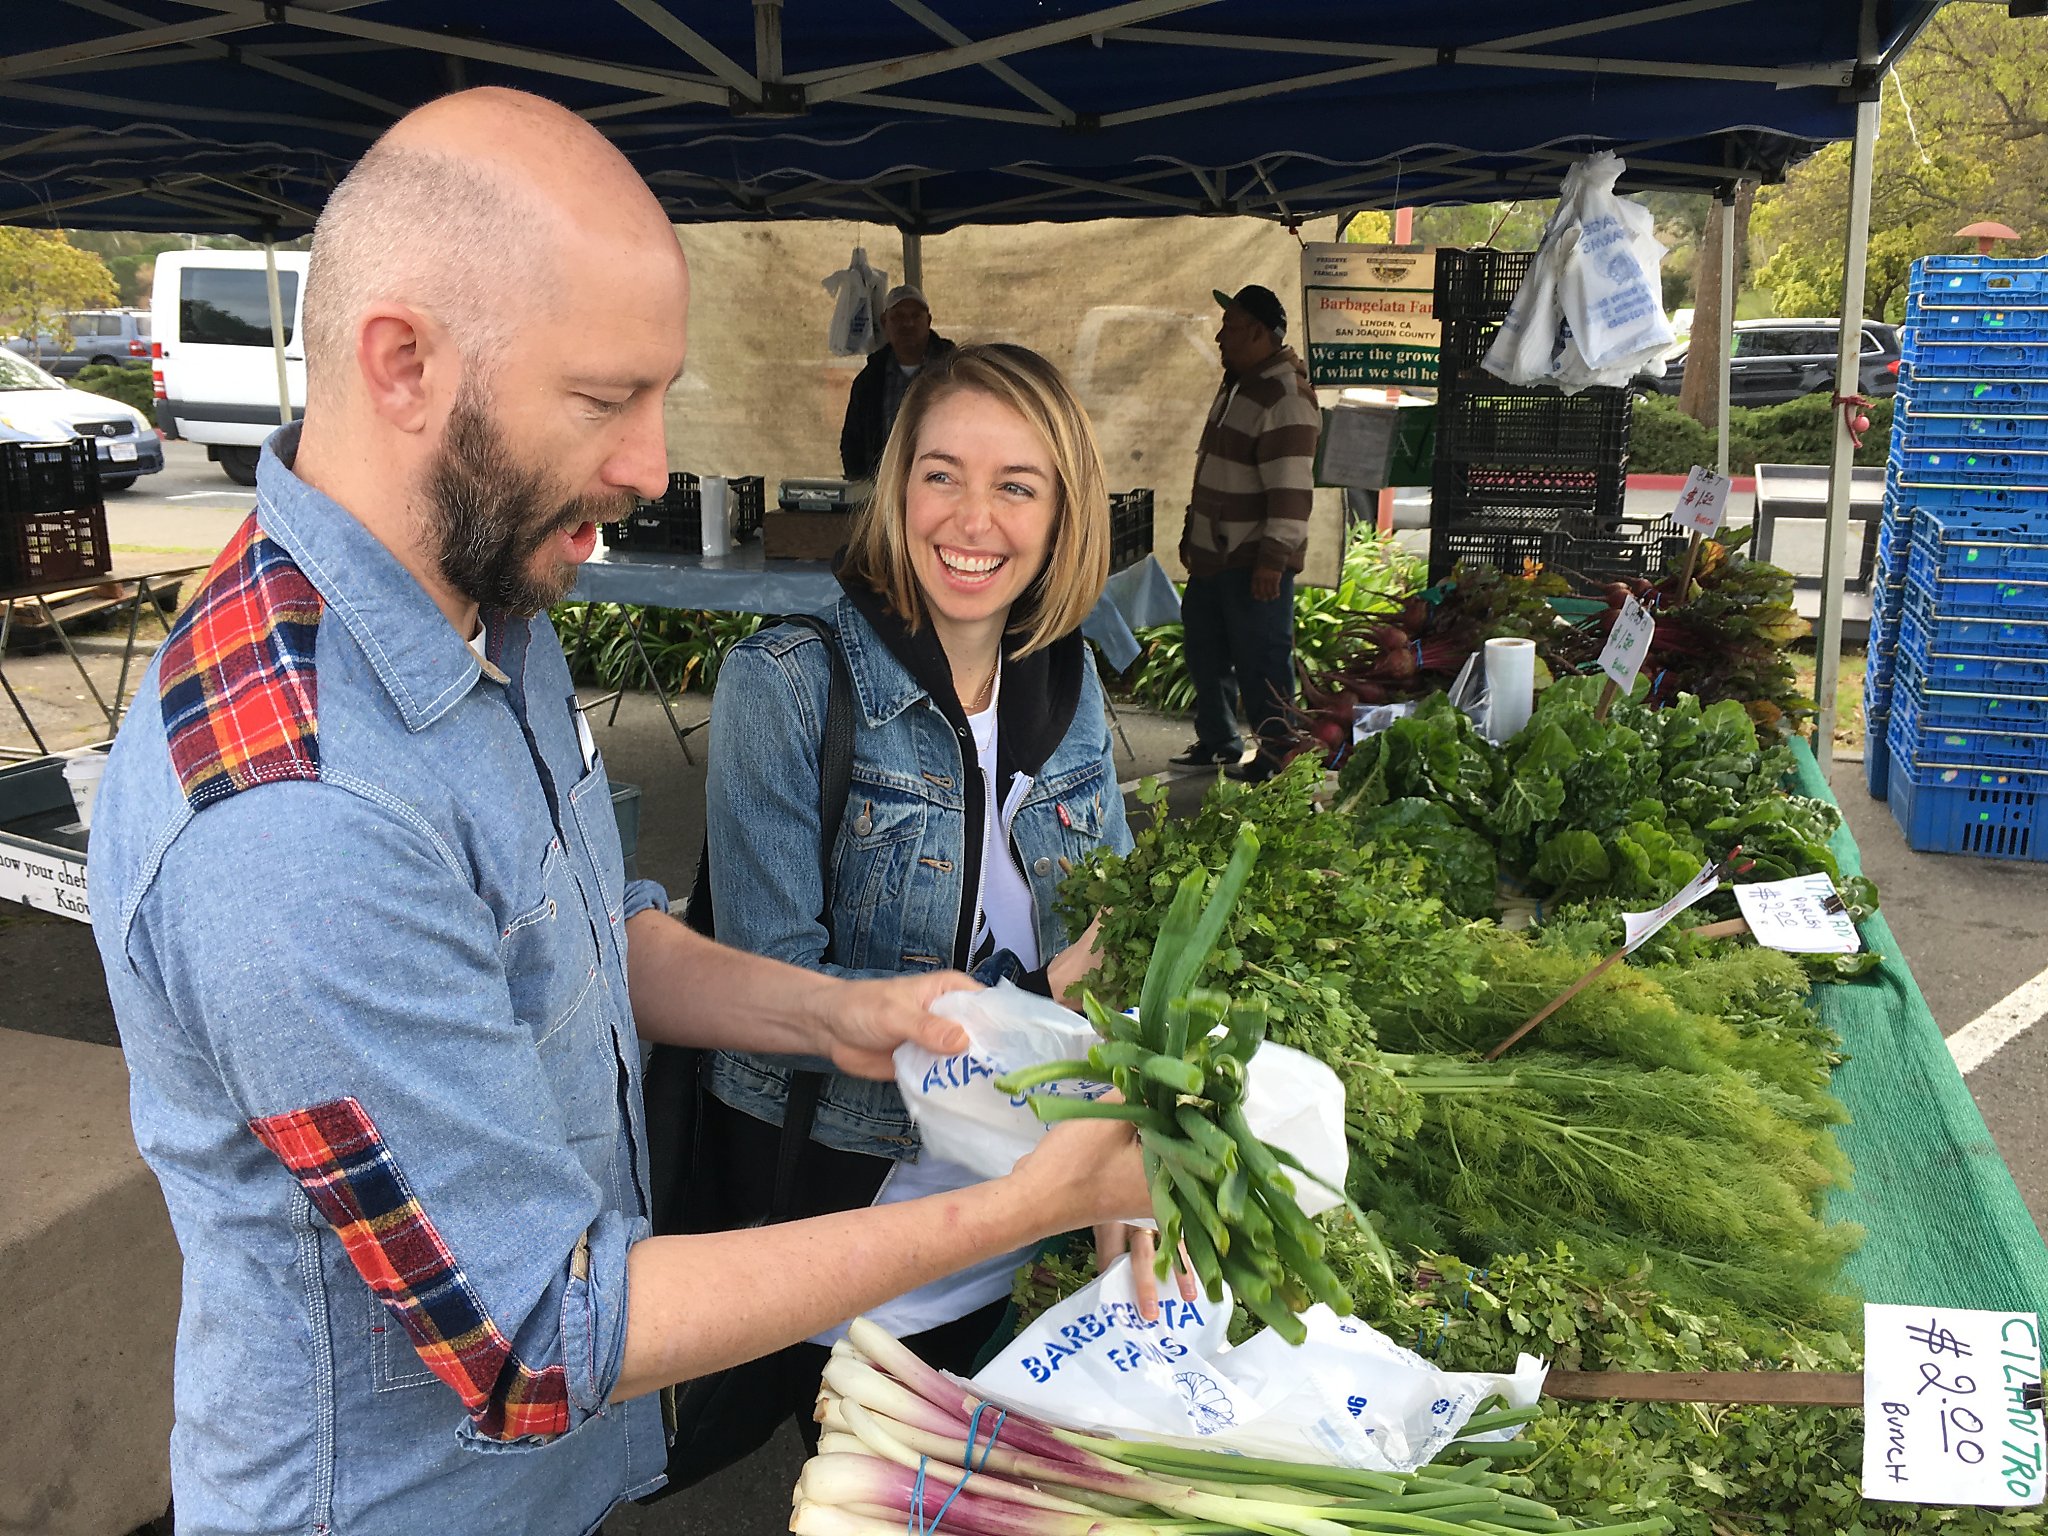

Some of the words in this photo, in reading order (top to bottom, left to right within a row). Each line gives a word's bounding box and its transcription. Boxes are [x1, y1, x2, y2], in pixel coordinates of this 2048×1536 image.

[1320, 297, 1406, 314] Barbagelata
[1400, 321, 1412, 329] CA
[1335, 328, 1353, 336] SAN
[1356, 329, 1396, 338] JOAQUIN
[1399, 330, 1436, 340] COUNTY
[1312, 347, 1335, 360] We
[1340, 349, 1364, 360] are
[1369, 347, 1393, 360] the
[1326, 366, 1366, 379] what
[1368, 369, 1389, 379] we
[1393, 367, 1416, 380] sell
[24, 862, 54, 880] your
[1905, 1318, 1985, 1464] $2.00
